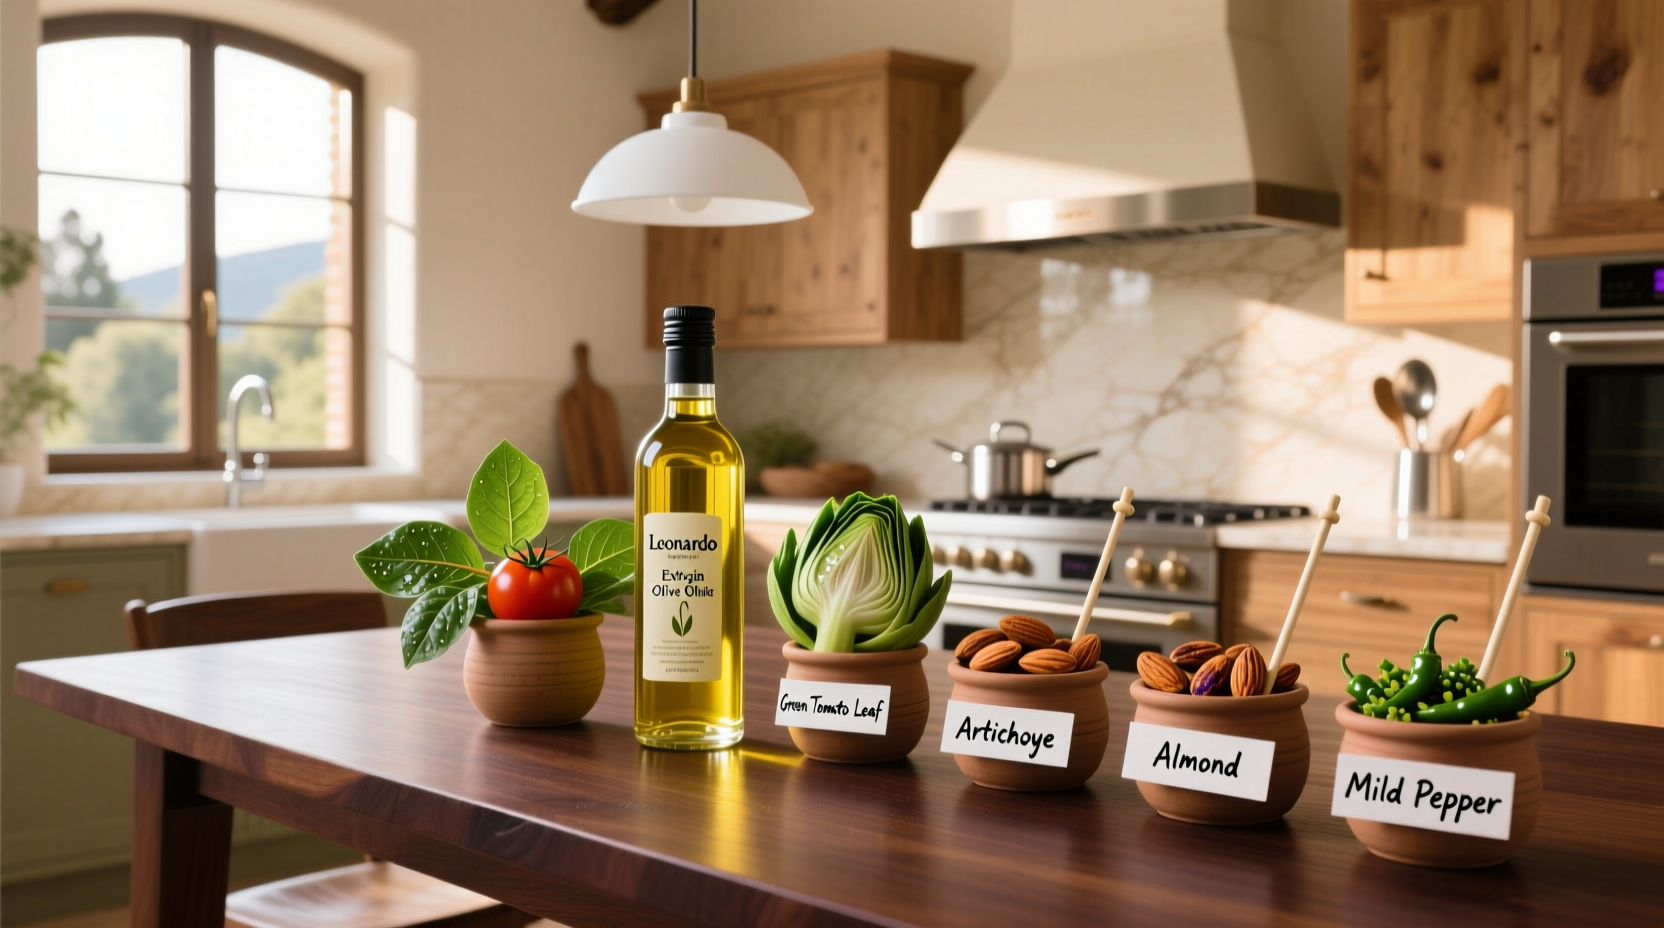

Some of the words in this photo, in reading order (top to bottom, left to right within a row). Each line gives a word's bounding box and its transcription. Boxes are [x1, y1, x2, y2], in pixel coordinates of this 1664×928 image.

[651, 584, 681, 597] Olive
[809, 695, 850, 716] Tomato
[853, 698, 885, 723] Leaf
[955, 716, 1055, 759] Artichoye
[1152, 740, 1242, 778] Almond
[1344, 771, 1405, 805] Mild
[1414, 779, 1502, 824] Pepper
